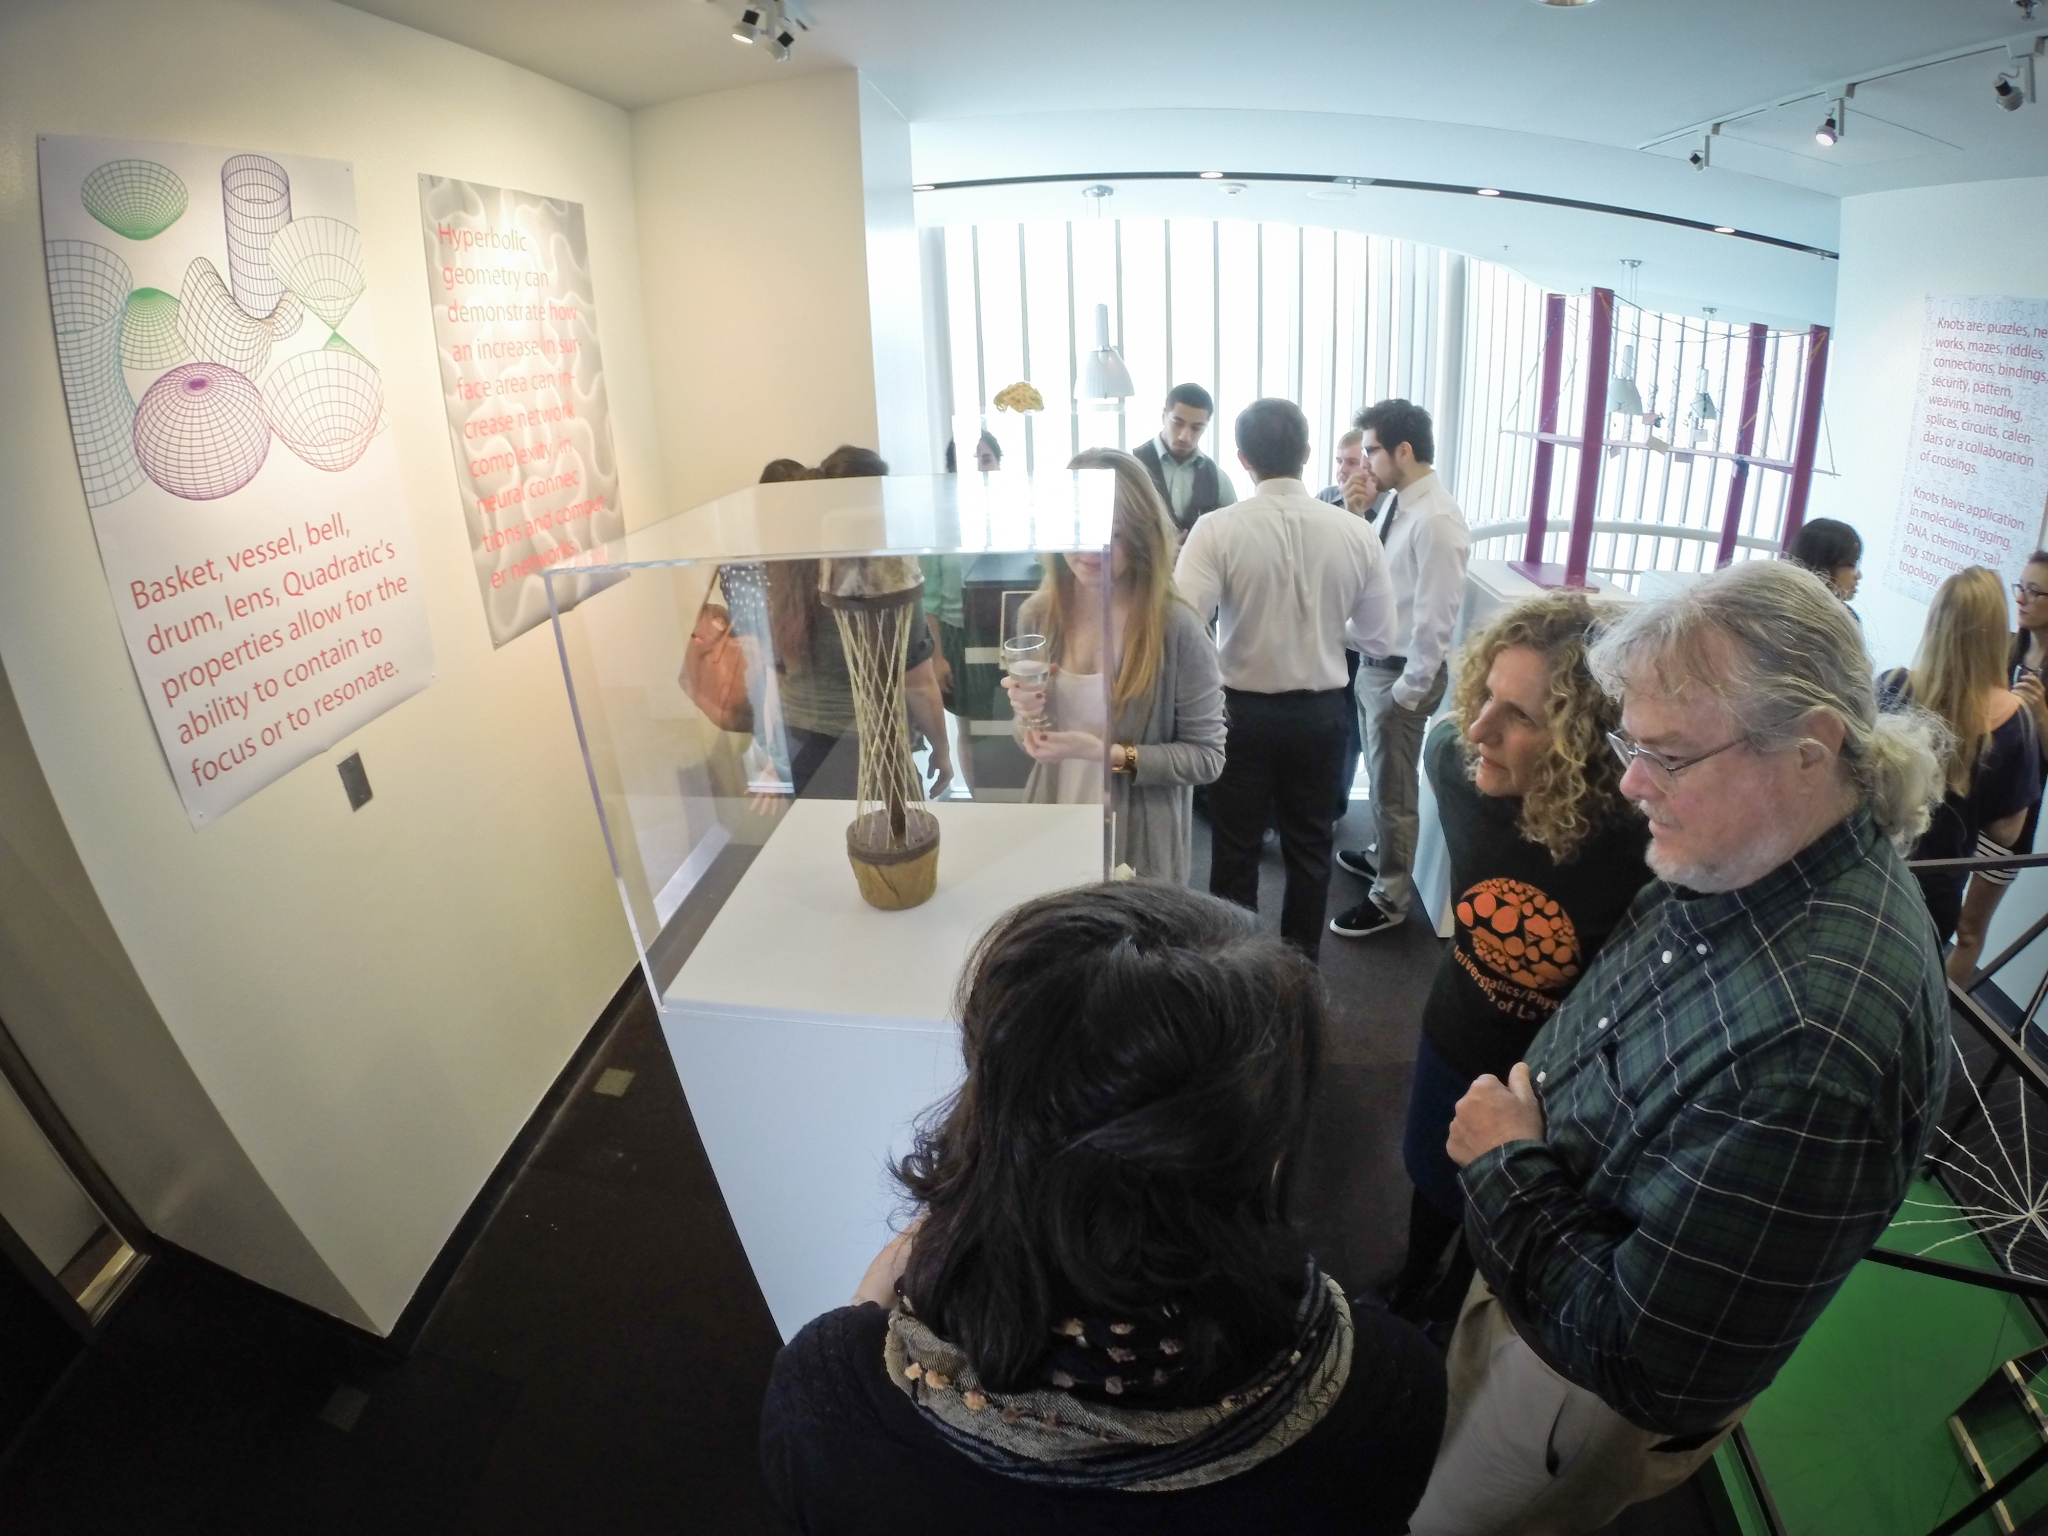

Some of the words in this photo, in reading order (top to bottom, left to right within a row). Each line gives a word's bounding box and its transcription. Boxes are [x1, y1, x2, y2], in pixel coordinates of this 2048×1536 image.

[438, 222, 527, 252] Hyperbolic
[443, 267, 521, 291] geometry
[525, 271, 549, 287] can
[448, 300, 546, 323] demonstrate
[549, 298, 577, 320] how
[1938, 317, 1965, 331] Knots
[1966, 321, 1985, 332] are:
[1987, 322, 2030, 338] puzzles,
[2034, 327, 2048, 339] ne
[453, 342, 472, 362] an
[477, 338, 539, 359] increase
[542, 337, 553, 353] in
[559, 338, 583, 354] sur-
[1935, 337, 1966, 351] works,
[1968, 341, 2003, 356] mazes,
[2006, 344, 2046, 362] riddles,
[457, 376, 491, 400] face
[496, 378, 527, 395] area
[531, 373, 555, 389] can
[557, 368, 575, 386] in-
[1933, 357, 1995, 376] connections,
[1998, 362, 2048, 384] bindings,
[1931, 376, 1970, 393] security,
[1973, 382, 2013, 399] pattern,
[464, 415, 513, 439] crease
[518, 402, 575, 428] network
[1929, 395, 1971, 413] weaving,
[1974, 402, 2023, 423] mending,
[1925, 413, 1959, 430] splices,
[1961, 420, 2000, 439] circuits,
[2002, 428, 2035, 444] calen-
[559, 436, 572, 454] in
[1923, 431, 1943, 446] dars
[1945, 438, 1956, 448] or
[1957, 441, 1963, 450] a
[1965, 442, 2034, 467] collaboration
[1920, 450, 1931, 461] of
[1931, 455, 1978, 475] crossings.
[477, 481, 525, 515] neural
[1913, 486, 1939, 504] Knots
[1941, 494, 1965, 511] have
[1966, 504, 2025, 531] application
[483, 525, 523, 552] tions
[526, 509, 553, 536] and
[1909, 504, 1919, 517] in
[1920, 510, 1971, 536] molecules,
[1973, 526, 2013, 551] rigging,
[1903, 541, 1919, 559] ing,
[1906, 522, 1929, 541] DNA,
[1931, 532, 1980, 560] chemistry,
[1983, 551, 2003, 567] sail-
[130, 559, 223, 610] Basket,
[227, 527, 302, 573] vessel,
[305, 512, 350, 546] bell,
[491, 567, 507, 589] er
[147, 611, 223, 655] drum,
[225, 587, 280, 621] lens,
[283, 539, 395, 596] Quadratic's
[162, 633, 284, 707] properties
[289, 603, 342, 641] allow
[345, 588, 373, 614] for
[377, 575, 408, 603] the
[178, 691, 248, 745] ability
[254, 677, 279, 702] to
[284, 638, 358, 688] contain
[361, 627, 382, 648] to
[191, 736, 256, 787] focus
[261, 719, 282, 747] or
[287, 707, 310, 731] to
[314, 660, 399, 717] resonate.
[1497, 1000, 1515, 1013] of
